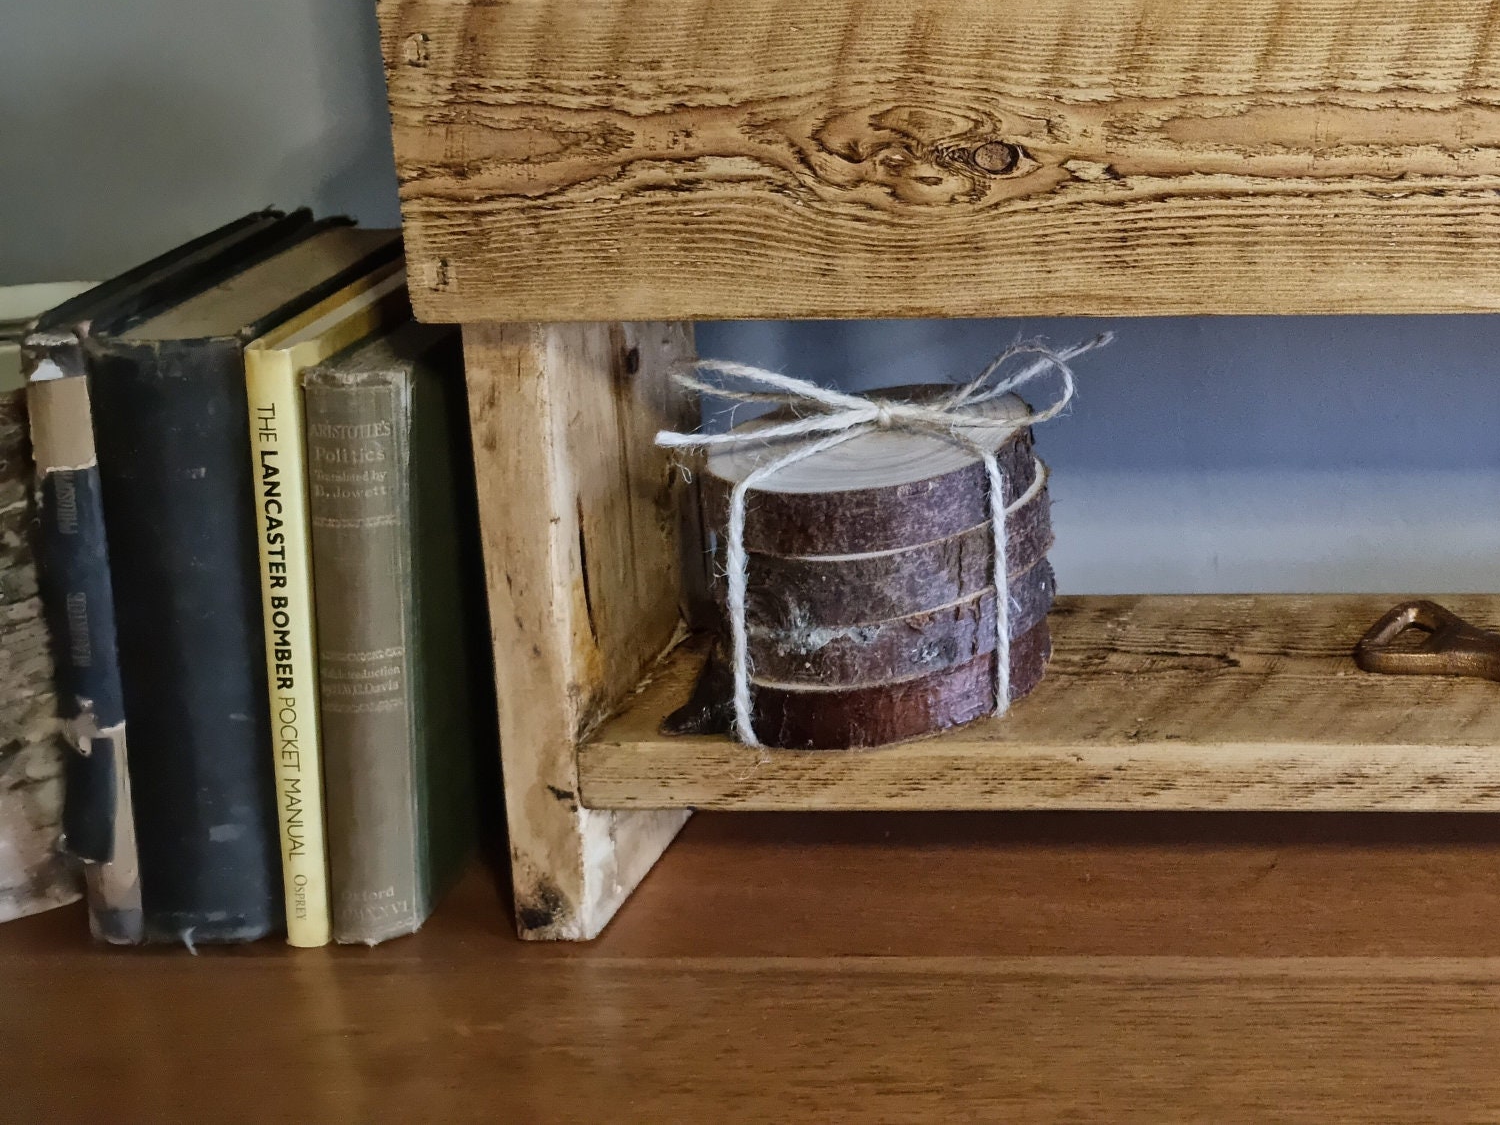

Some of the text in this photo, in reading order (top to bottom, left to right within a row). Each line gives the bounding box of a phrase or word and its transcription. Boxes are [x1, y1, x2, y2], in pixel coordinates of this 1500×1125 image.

[257, 402, 305, 862] THE LANCASTER BOMBER POCKET MANUAL
[293, 874, 308, 921] OSPREY
